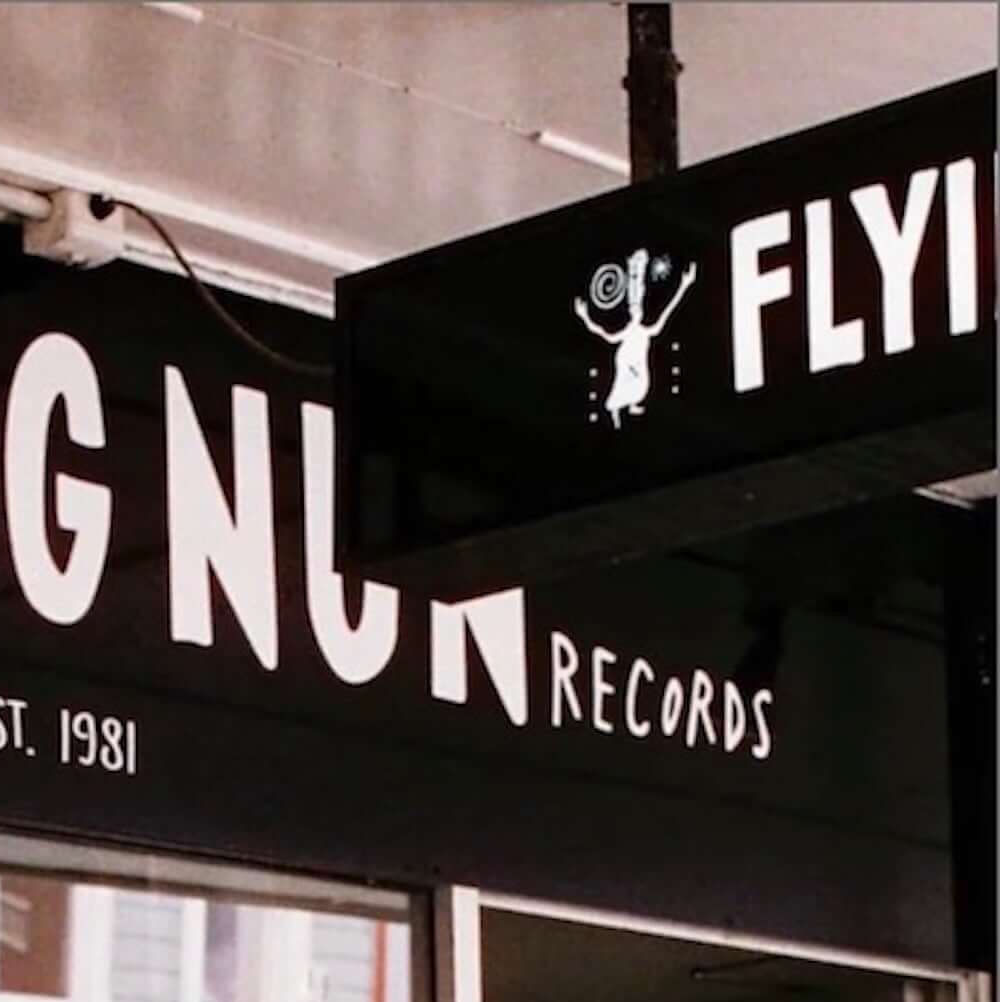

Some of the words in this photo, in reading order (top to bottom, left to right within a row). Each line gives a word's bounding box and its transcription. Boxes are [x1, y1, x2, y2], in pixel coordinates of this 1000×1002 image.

[731, 157, 997, 392] FLYI
[61, 709, 136, 774] 1981
[551, 631, 772, 760] RECORDS
